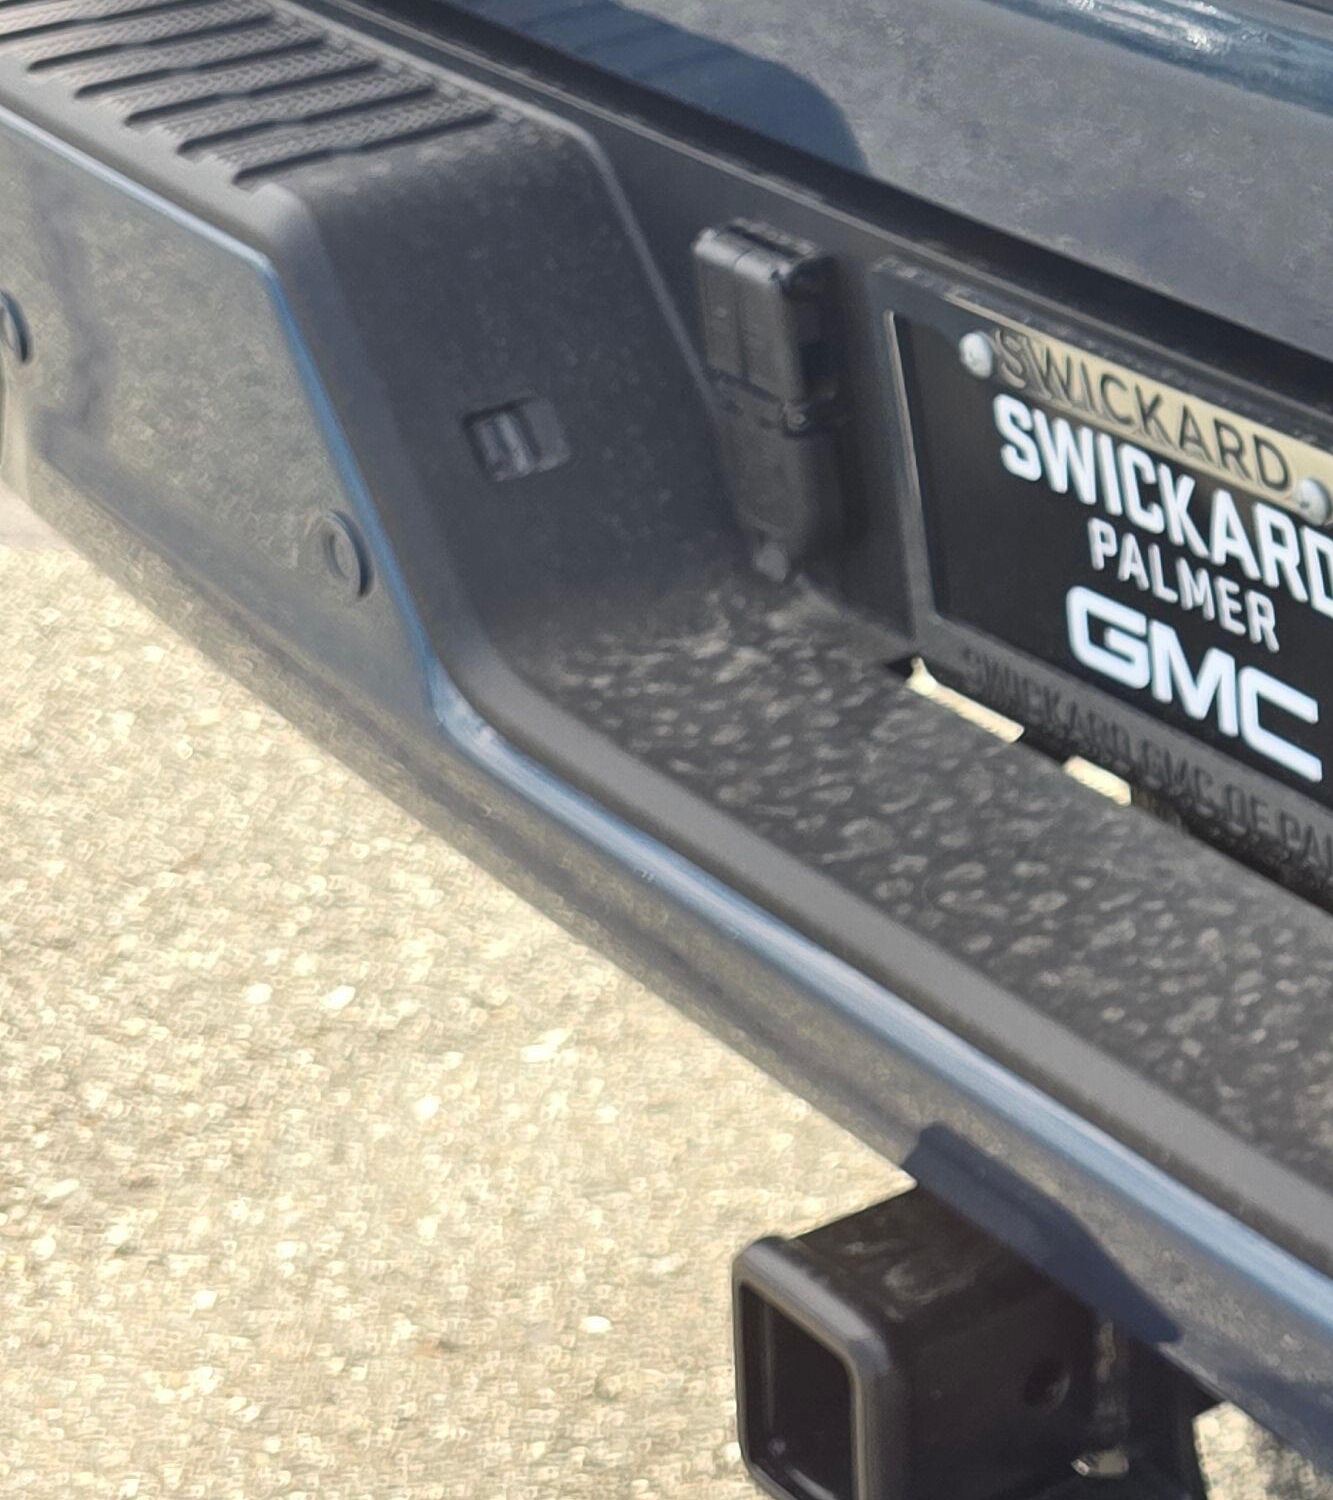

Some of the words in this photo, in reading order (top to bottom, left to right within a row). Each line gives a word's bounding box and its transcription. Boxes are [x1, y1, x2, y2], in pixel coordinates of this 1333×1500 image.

[994, 328, 1293, 495] SWICKARD
[1086, 517, 1280, 653] PALMER
[1066, 585, 1323, 783] GMC
